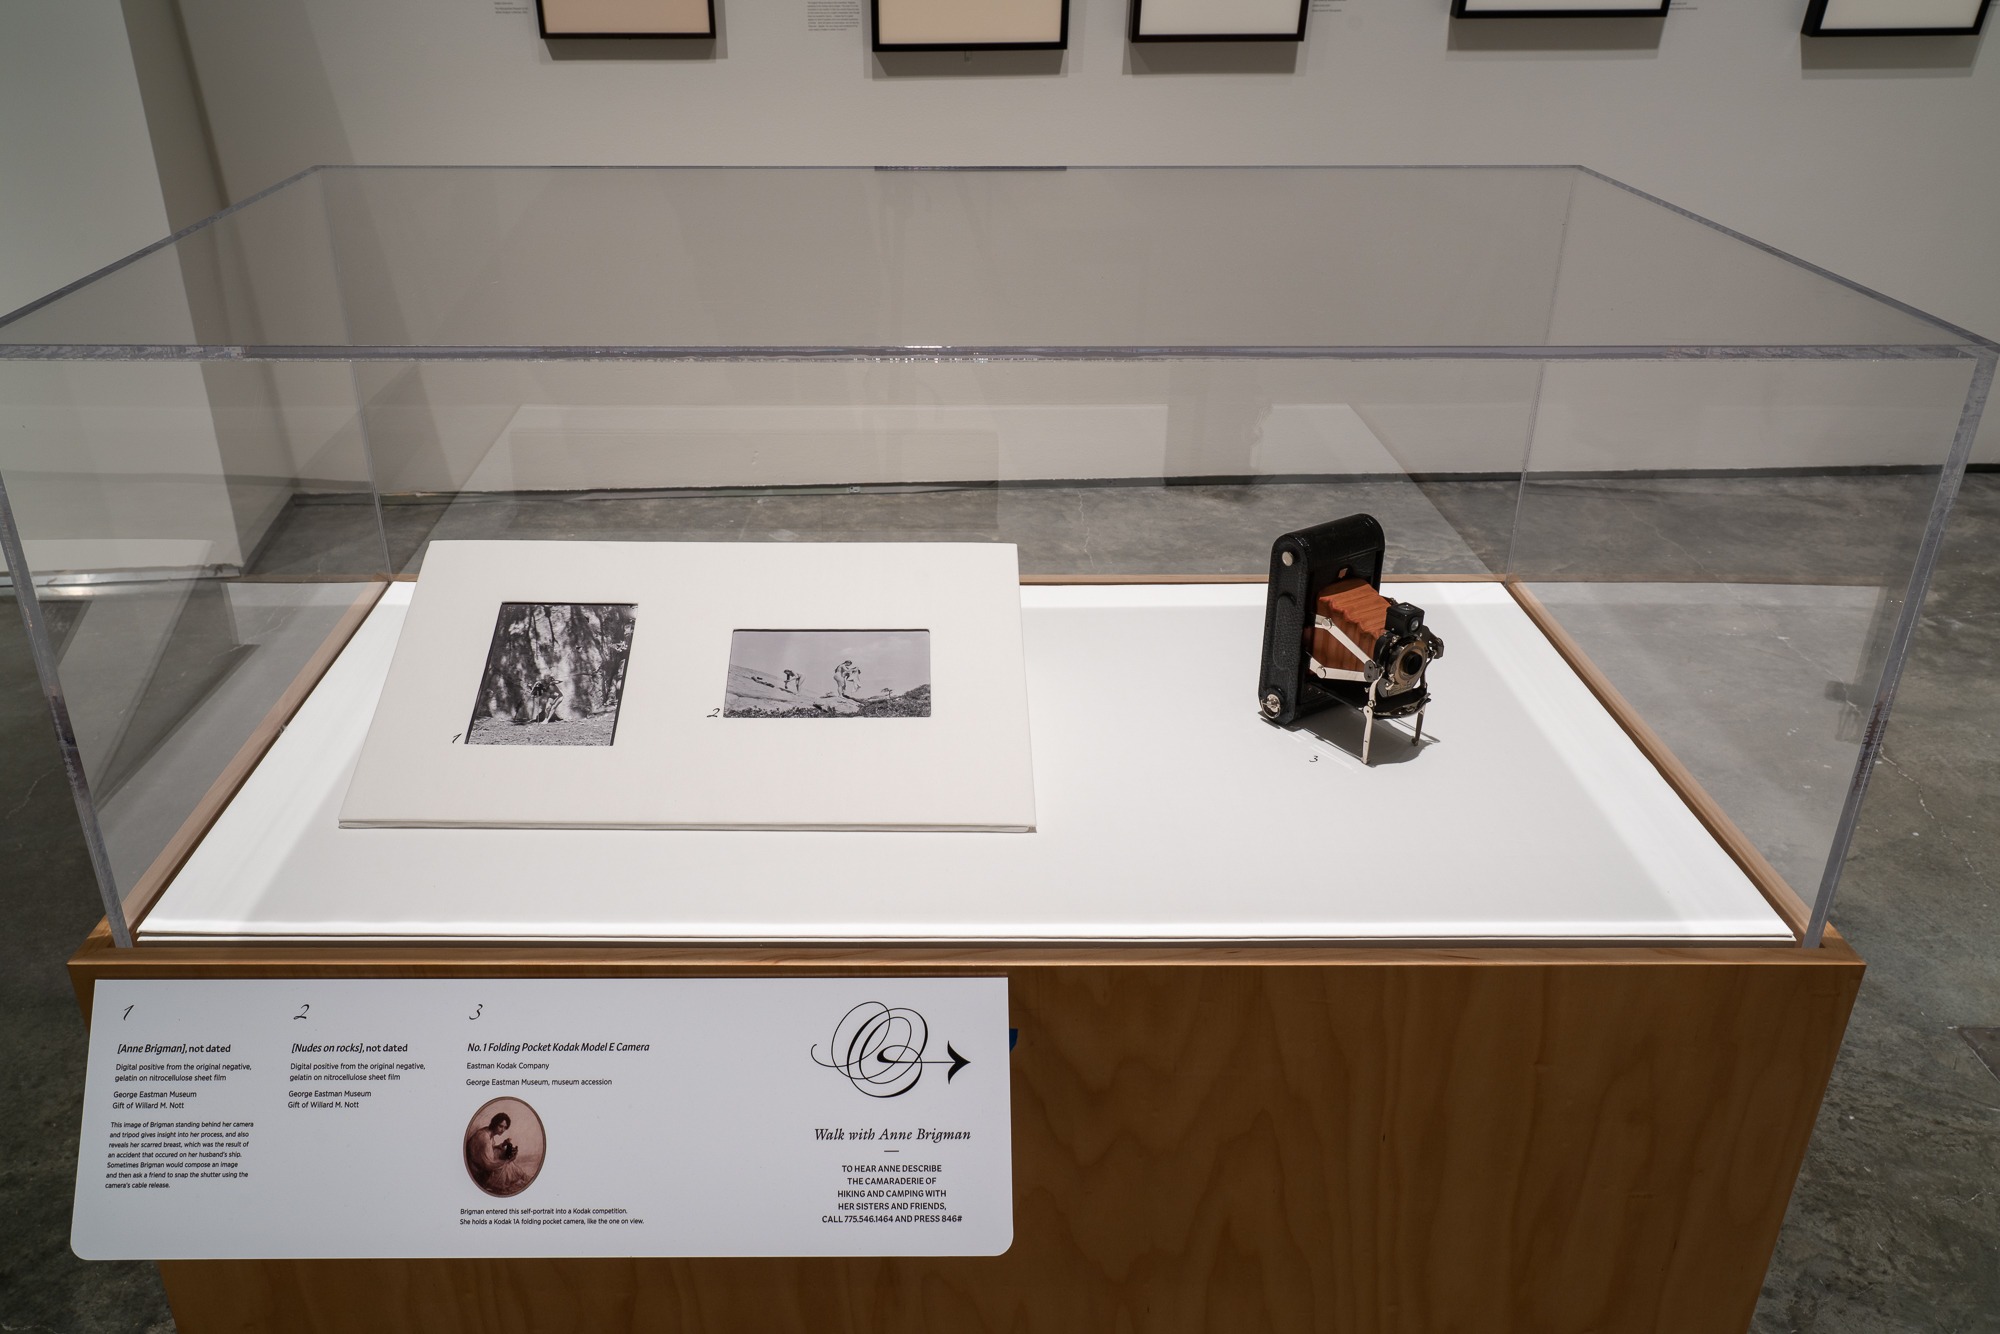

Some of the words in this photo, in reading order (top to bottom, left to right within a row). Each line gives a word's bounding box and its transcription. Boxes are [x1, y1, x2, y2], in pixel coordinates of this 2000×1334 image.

[707, 708, 720, 718] 2
[452, 733, 462, 744] 1
[123, 1005, 134, 1021] 1
[293, 1004, 309, 1020] 2
[469, 1004, 483, 1020] 3
[117, 1044, 143, 1054] [Anne
[144, 1044, 187, 1055] Brigman],
[189, 1045, 204, 1053] not
[206, 1044, 231, 1052] dated
[291, 1043, 322, 1054] [Nudes
[336, 1043, 364, 1053] rocks],
[383, 1044, 408, 1052] dated
[467, 1043, 481, 1052] No.
[483, 1043, 487, 1051] 1
[488, 1043, 520, 1054] Folding
[522, 1043, 551, 1051] Pocket
[553, 1042, 580, 1051] Kodak
[581, 1042, 608, 1051] Model
[609, 1042, 615, 1051] E
[616, 1043, 650, 1051] Camera
[196, 1063, 221, 1071] original
[222, 1063, 251, 1071] negative,
[290, 1063, 312, 1071] Digital
[518, 1062, 549, 1070] Company
[115, 1075, 137, 1083] gelatin
[290, 1074, 312, 1082] gelatin
[466, 1079, 490, 1087] George
[113, 1091, 138, 1099] George
[289, 1090, 313, 1098] George
[815, 1128, 844, 1140] Walk
[849, 1128, 875, 1140] with
[878, 1128, 912, 1140] Anne
[916, 1128, 971, 1143] Brigman
[865, 1177, 924, 1185] CAMARADERIE
[925, 1177, 936, 1185] OF
[910, 1202, 946, 1210] FRIENDS,
[822, 1215, 843, 1223] CALL
[844, 1215, 893, 1223] 775.546.1464
